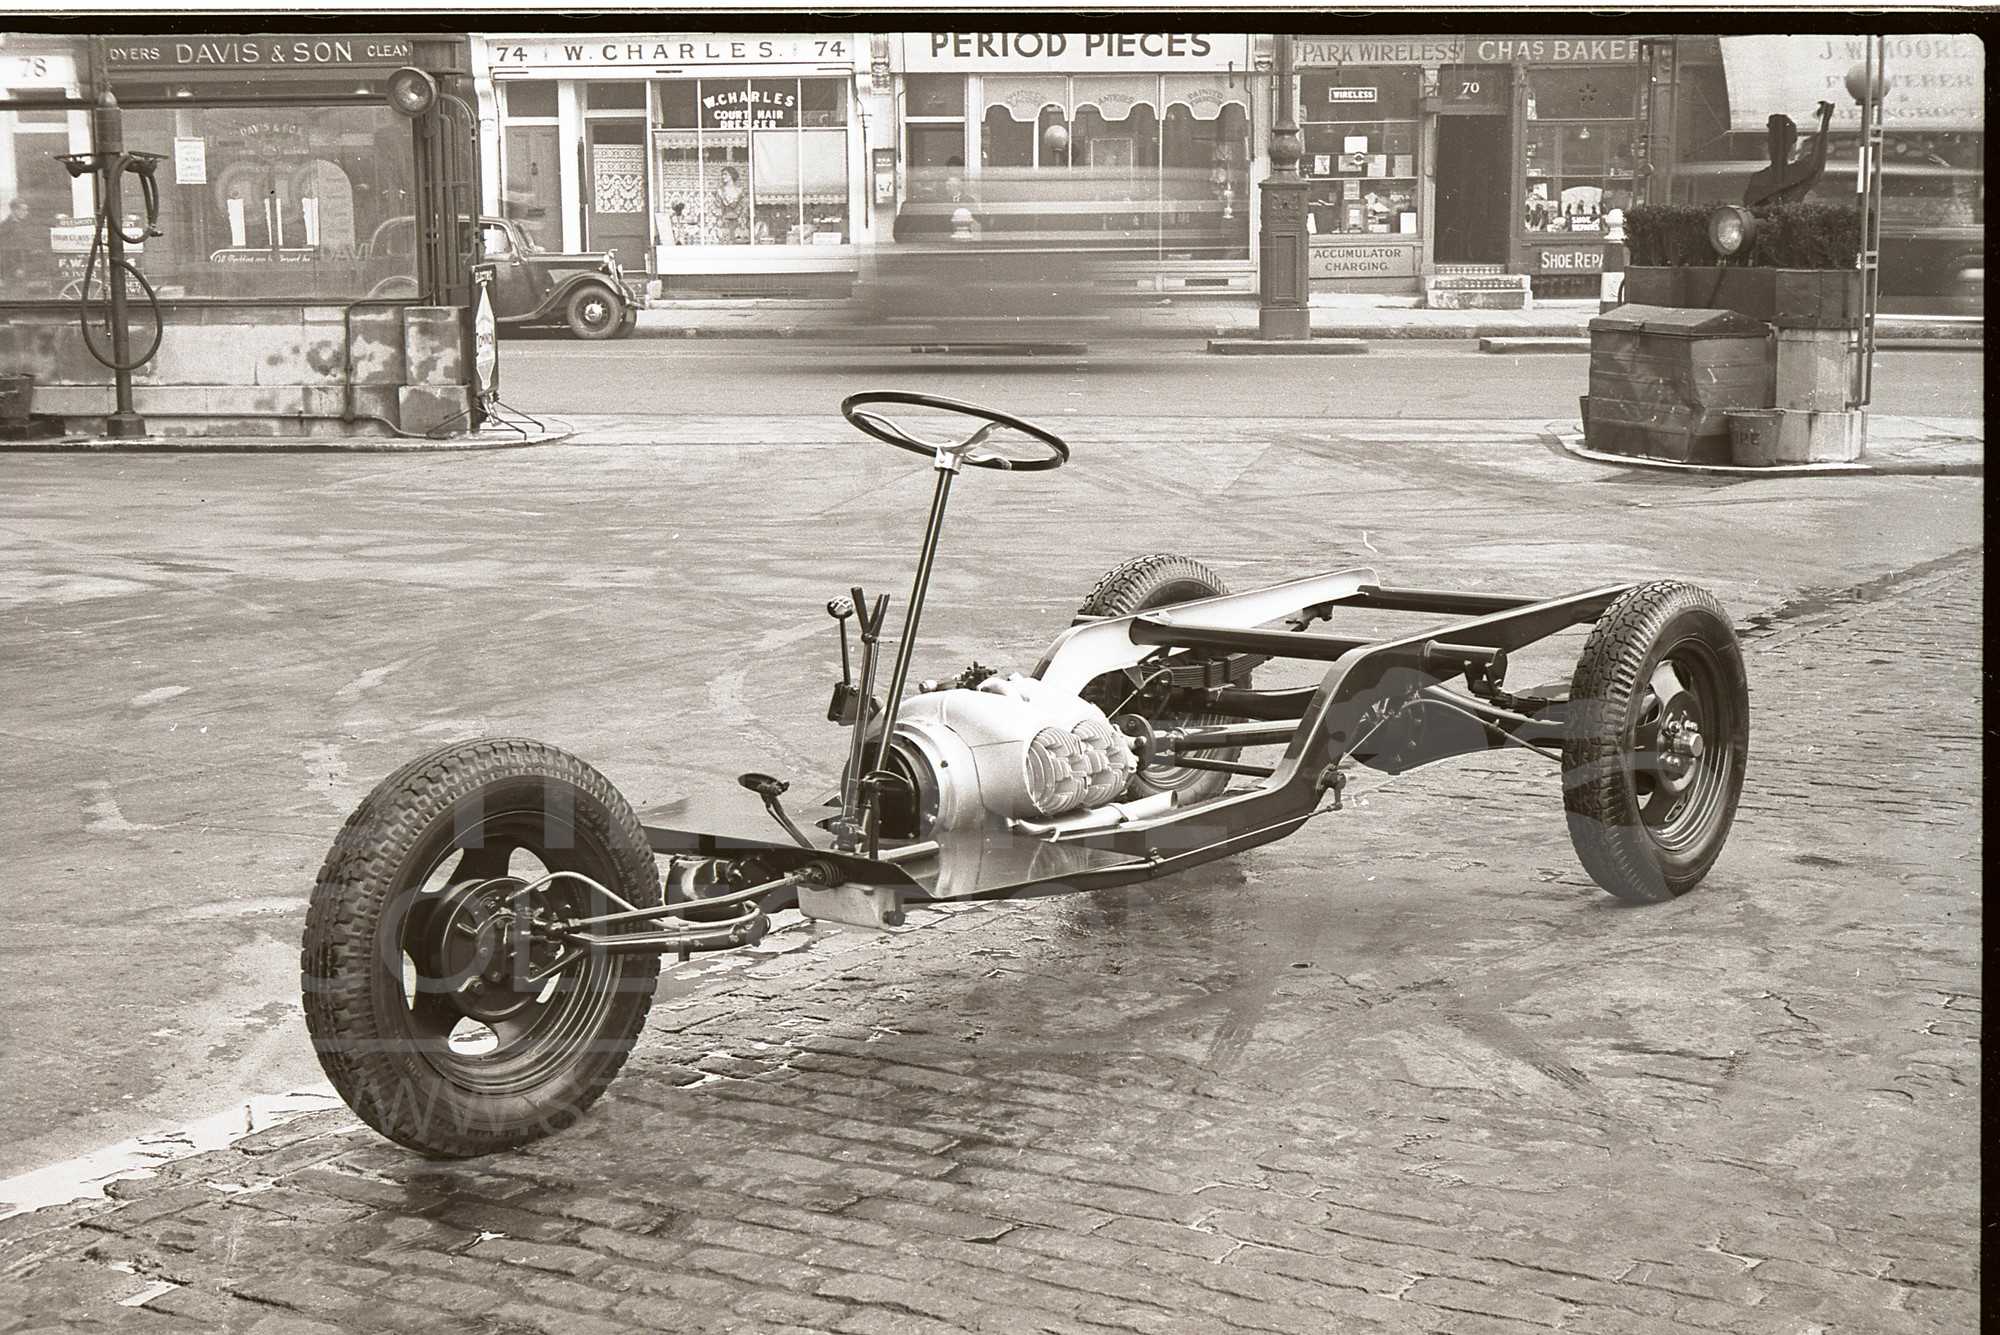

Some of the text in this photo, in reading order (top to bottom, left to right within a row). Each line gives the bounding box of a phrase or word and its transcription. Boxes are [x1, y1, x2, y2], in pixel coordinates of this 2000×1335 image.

[109, 47, 161, 60] DYERS
[175, 43, 260, 64] DAVIS
[271, 44, 286, 63] &
[293, 41, 353, 63] SON
[496, 46, 528, 62] 74
[814, 40, 847, 57] 74
[931, 32, 1212, 58] PERIOD PIECES
[1303, 41, 1461, 62] PARK WIRELESS
[17, 57, 48, 77] 78
[1332, 90, 1374, 99] WIRELESS
[1462, 82, 1480, 94] 70
[714, 110, 784, 120] COURT HAIR
[720, 120, 777, 128] DRESSER
[1314, 248, 1402, 259] ACCUMULATOR
[1541, 251, 1573, 269] SHOE
[1325, 261, 1389, 272] CHARGING
